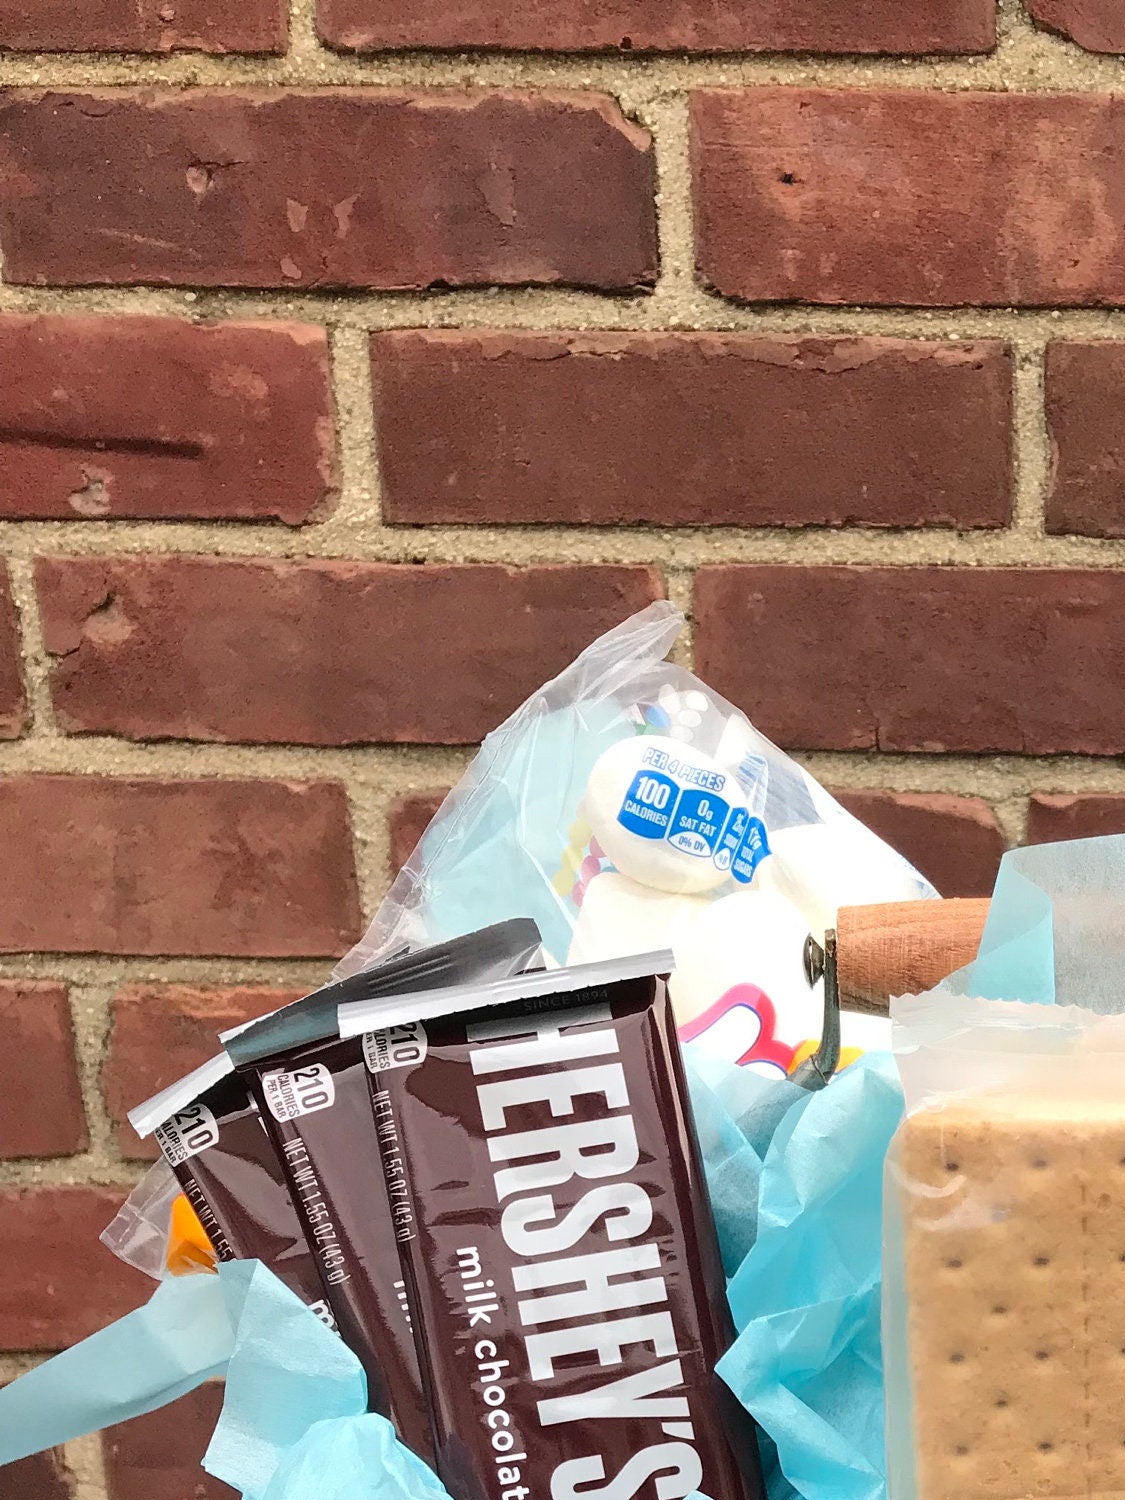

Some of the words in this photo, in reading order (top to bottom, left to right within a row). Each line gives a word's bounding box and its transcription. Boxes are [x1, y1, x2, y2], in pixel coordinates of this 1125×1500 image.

[642, 747, 669, 770] PER
[668, 759, 680, 774] 4
[678, 764, 726, 792] PIECES
[635, 776, 671, 809] 100
[624, 800, 669, 827] CALORIES
[697, 799, 714, 821] 0g
[679, 816, 697, 830] SAT
[699, 821, 717, 838] FAT
[694, 840, 706, 852] DV
[523, 994, 573, 1012] SINCE
[575, 989, 609, 1002] 1894
[373, 1028, 391, 1069] LORIES
[389, 1022, 421, 1063] 210
[266, 1079, 279, 1092] PER
[274, 1102, 287, 1119] BAR
[277, 1073, 300, 1117] CALORIES
[294, 1068, 328, 1109] 210
[372, 1090, 393, 1118] NET
[161, 1121, 188, 1160] ALORIES
[174, 1107, 213, 1150] 210
[377, 1120, 398, 1144] WT
[165, 1147, 176, 1163] BAR
[283, 1137, 308, 1166] NET
[292, 1166, 318, 1191] WT
[388, 1179, 408, 1201] OZ
[184, 1178, 204, 1204] NET
[199, 1206, 217, 1229] WT
[302, 1191, 329, 1223] 1.55
[313, 1222, 336, 1244] OZ
[318, 1244, 345, 1269] (43
[327, 1269, 351, 1286] g)
[456, 1246, 500, 1327] milk
